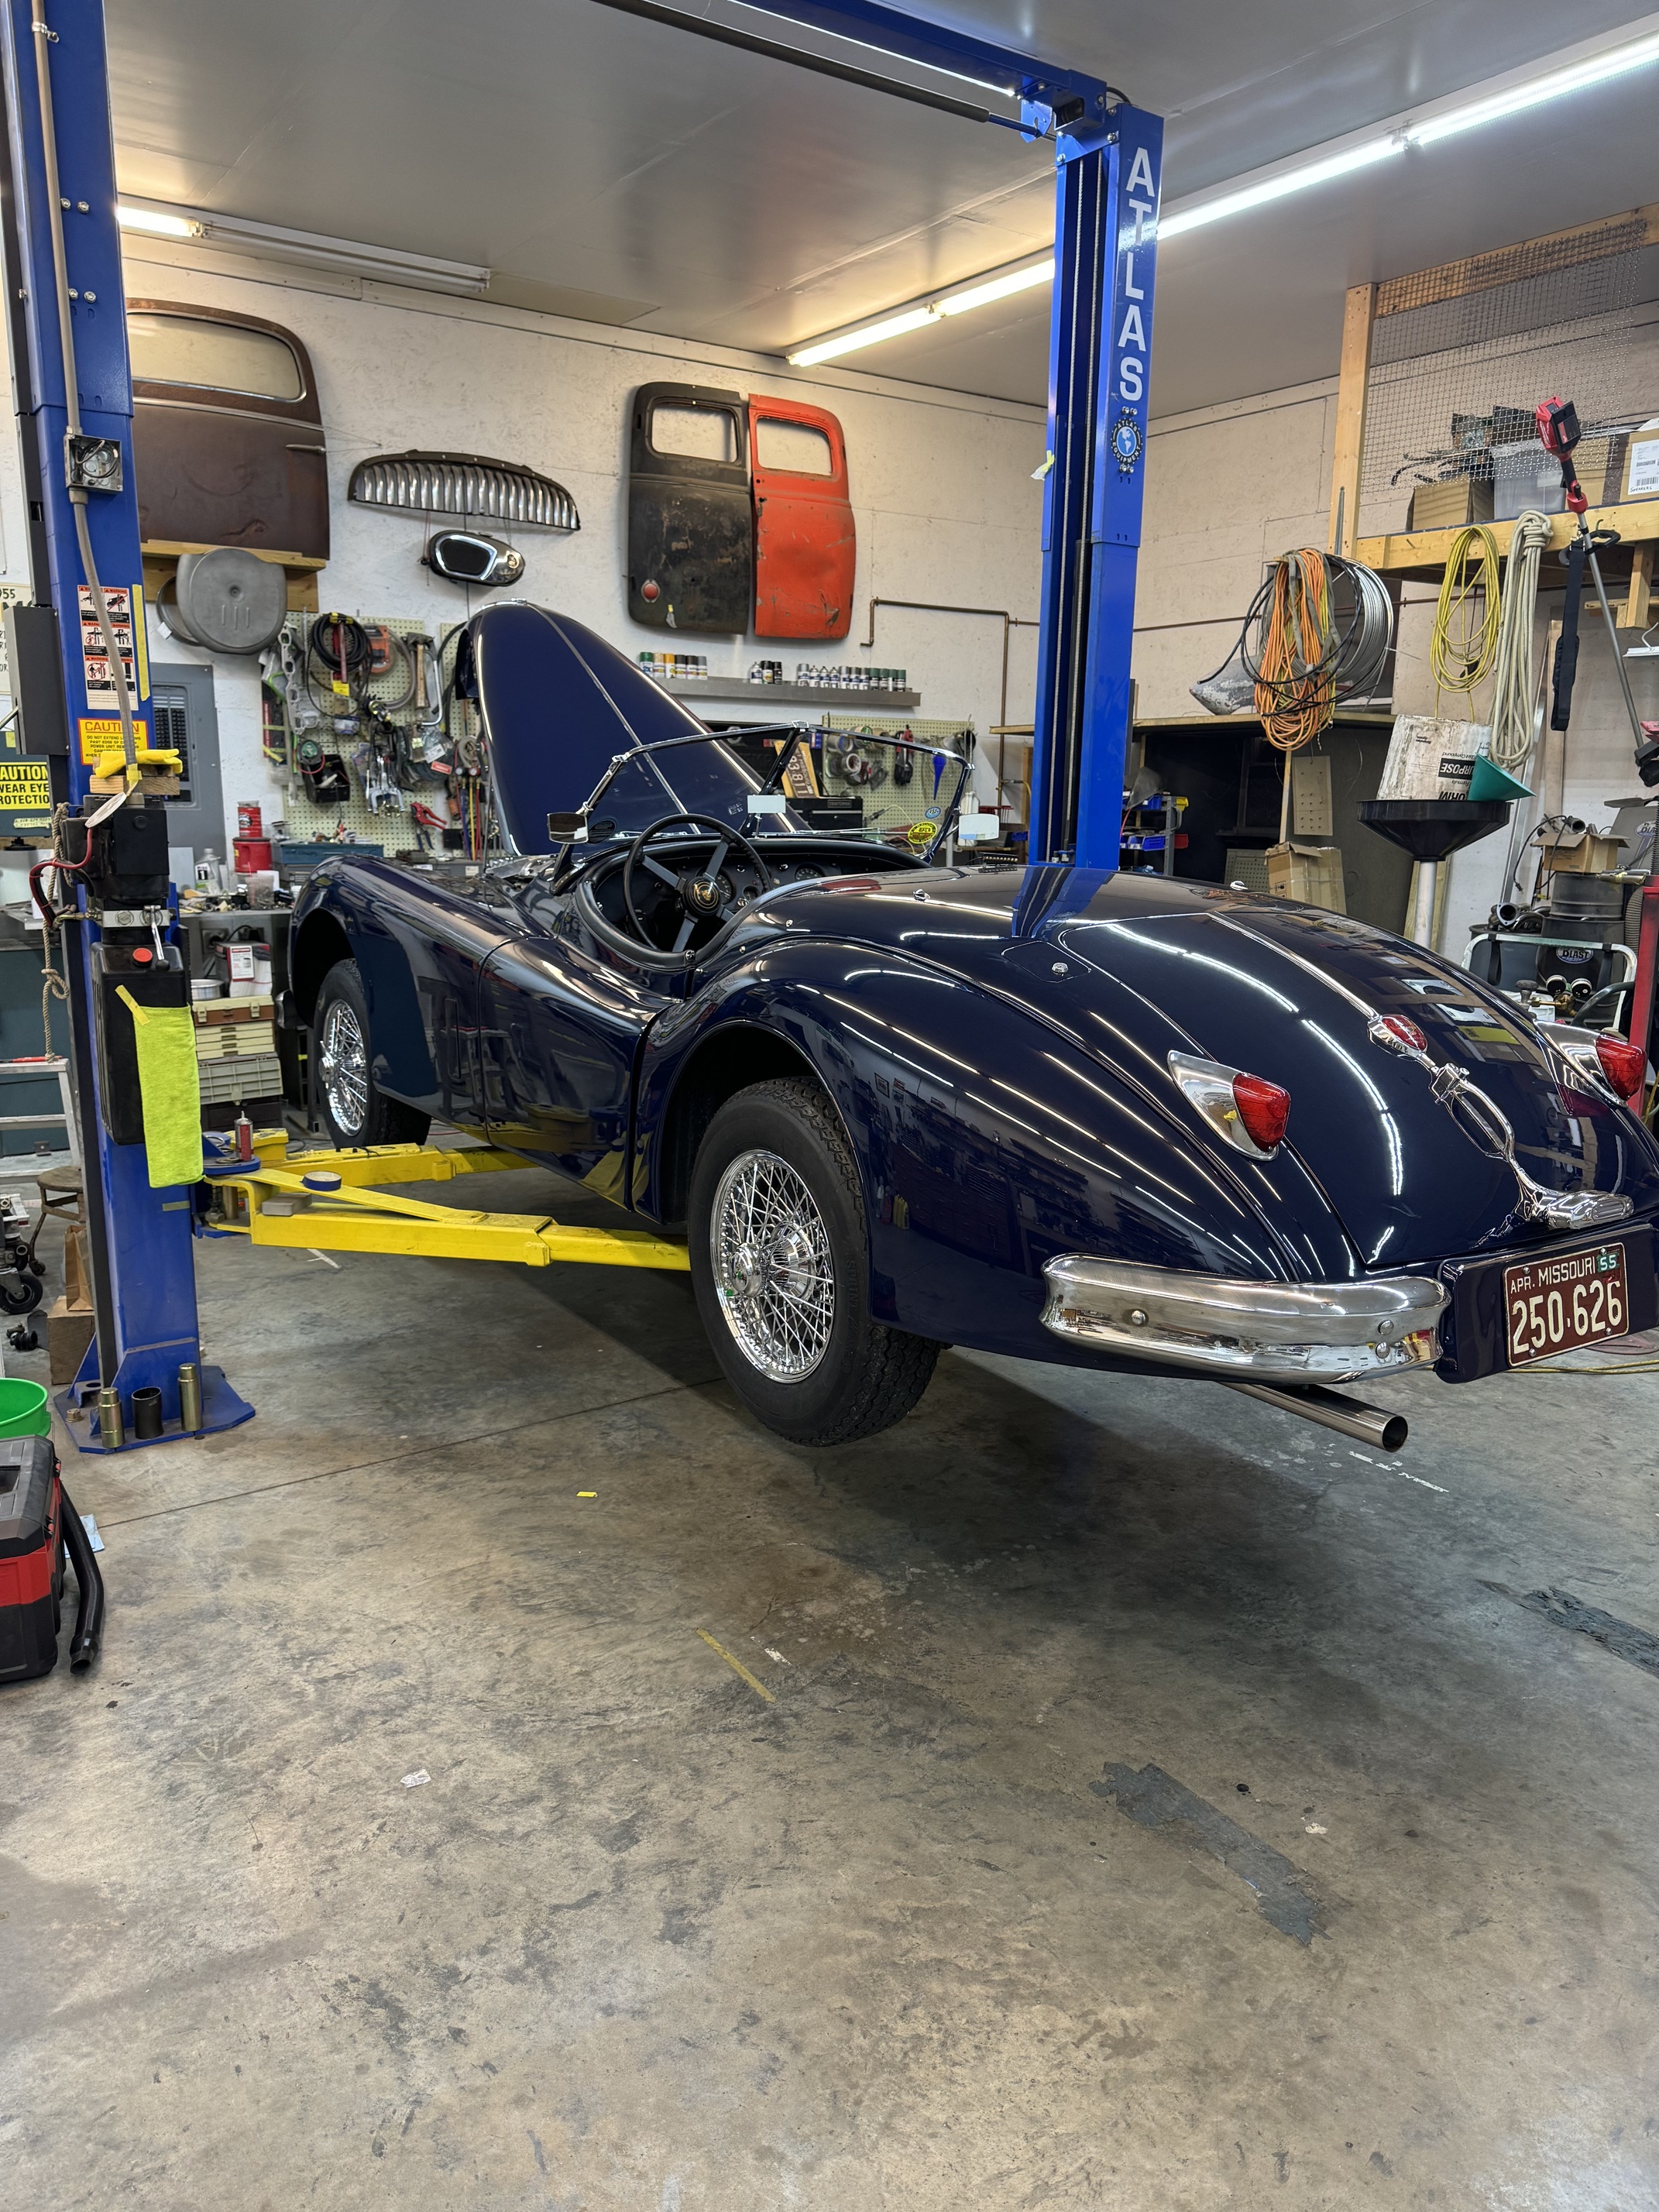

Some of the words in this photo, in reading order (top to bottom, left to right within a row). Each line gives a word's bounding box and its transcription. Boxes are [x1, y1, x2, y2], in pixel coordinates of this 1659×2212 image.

[1117, 146, 1155, 401] ATLAS
[1118, 420, 1138, 431] ATLAS
[1112, 441, 1141, 463] EQUIPMENT
[0, 588, 15, 599] 55
[85, 721, 139, 732] CAUTIN
[0, 766, 49, 781] AUTION
[0, 795, 50, 805] ROTECTIO
[1510, 1276, 1536, 1294] APR.
[1537, 1255, 1596, 1288] MISSOURI
[1599, 1254, 1617, 1272] 55
